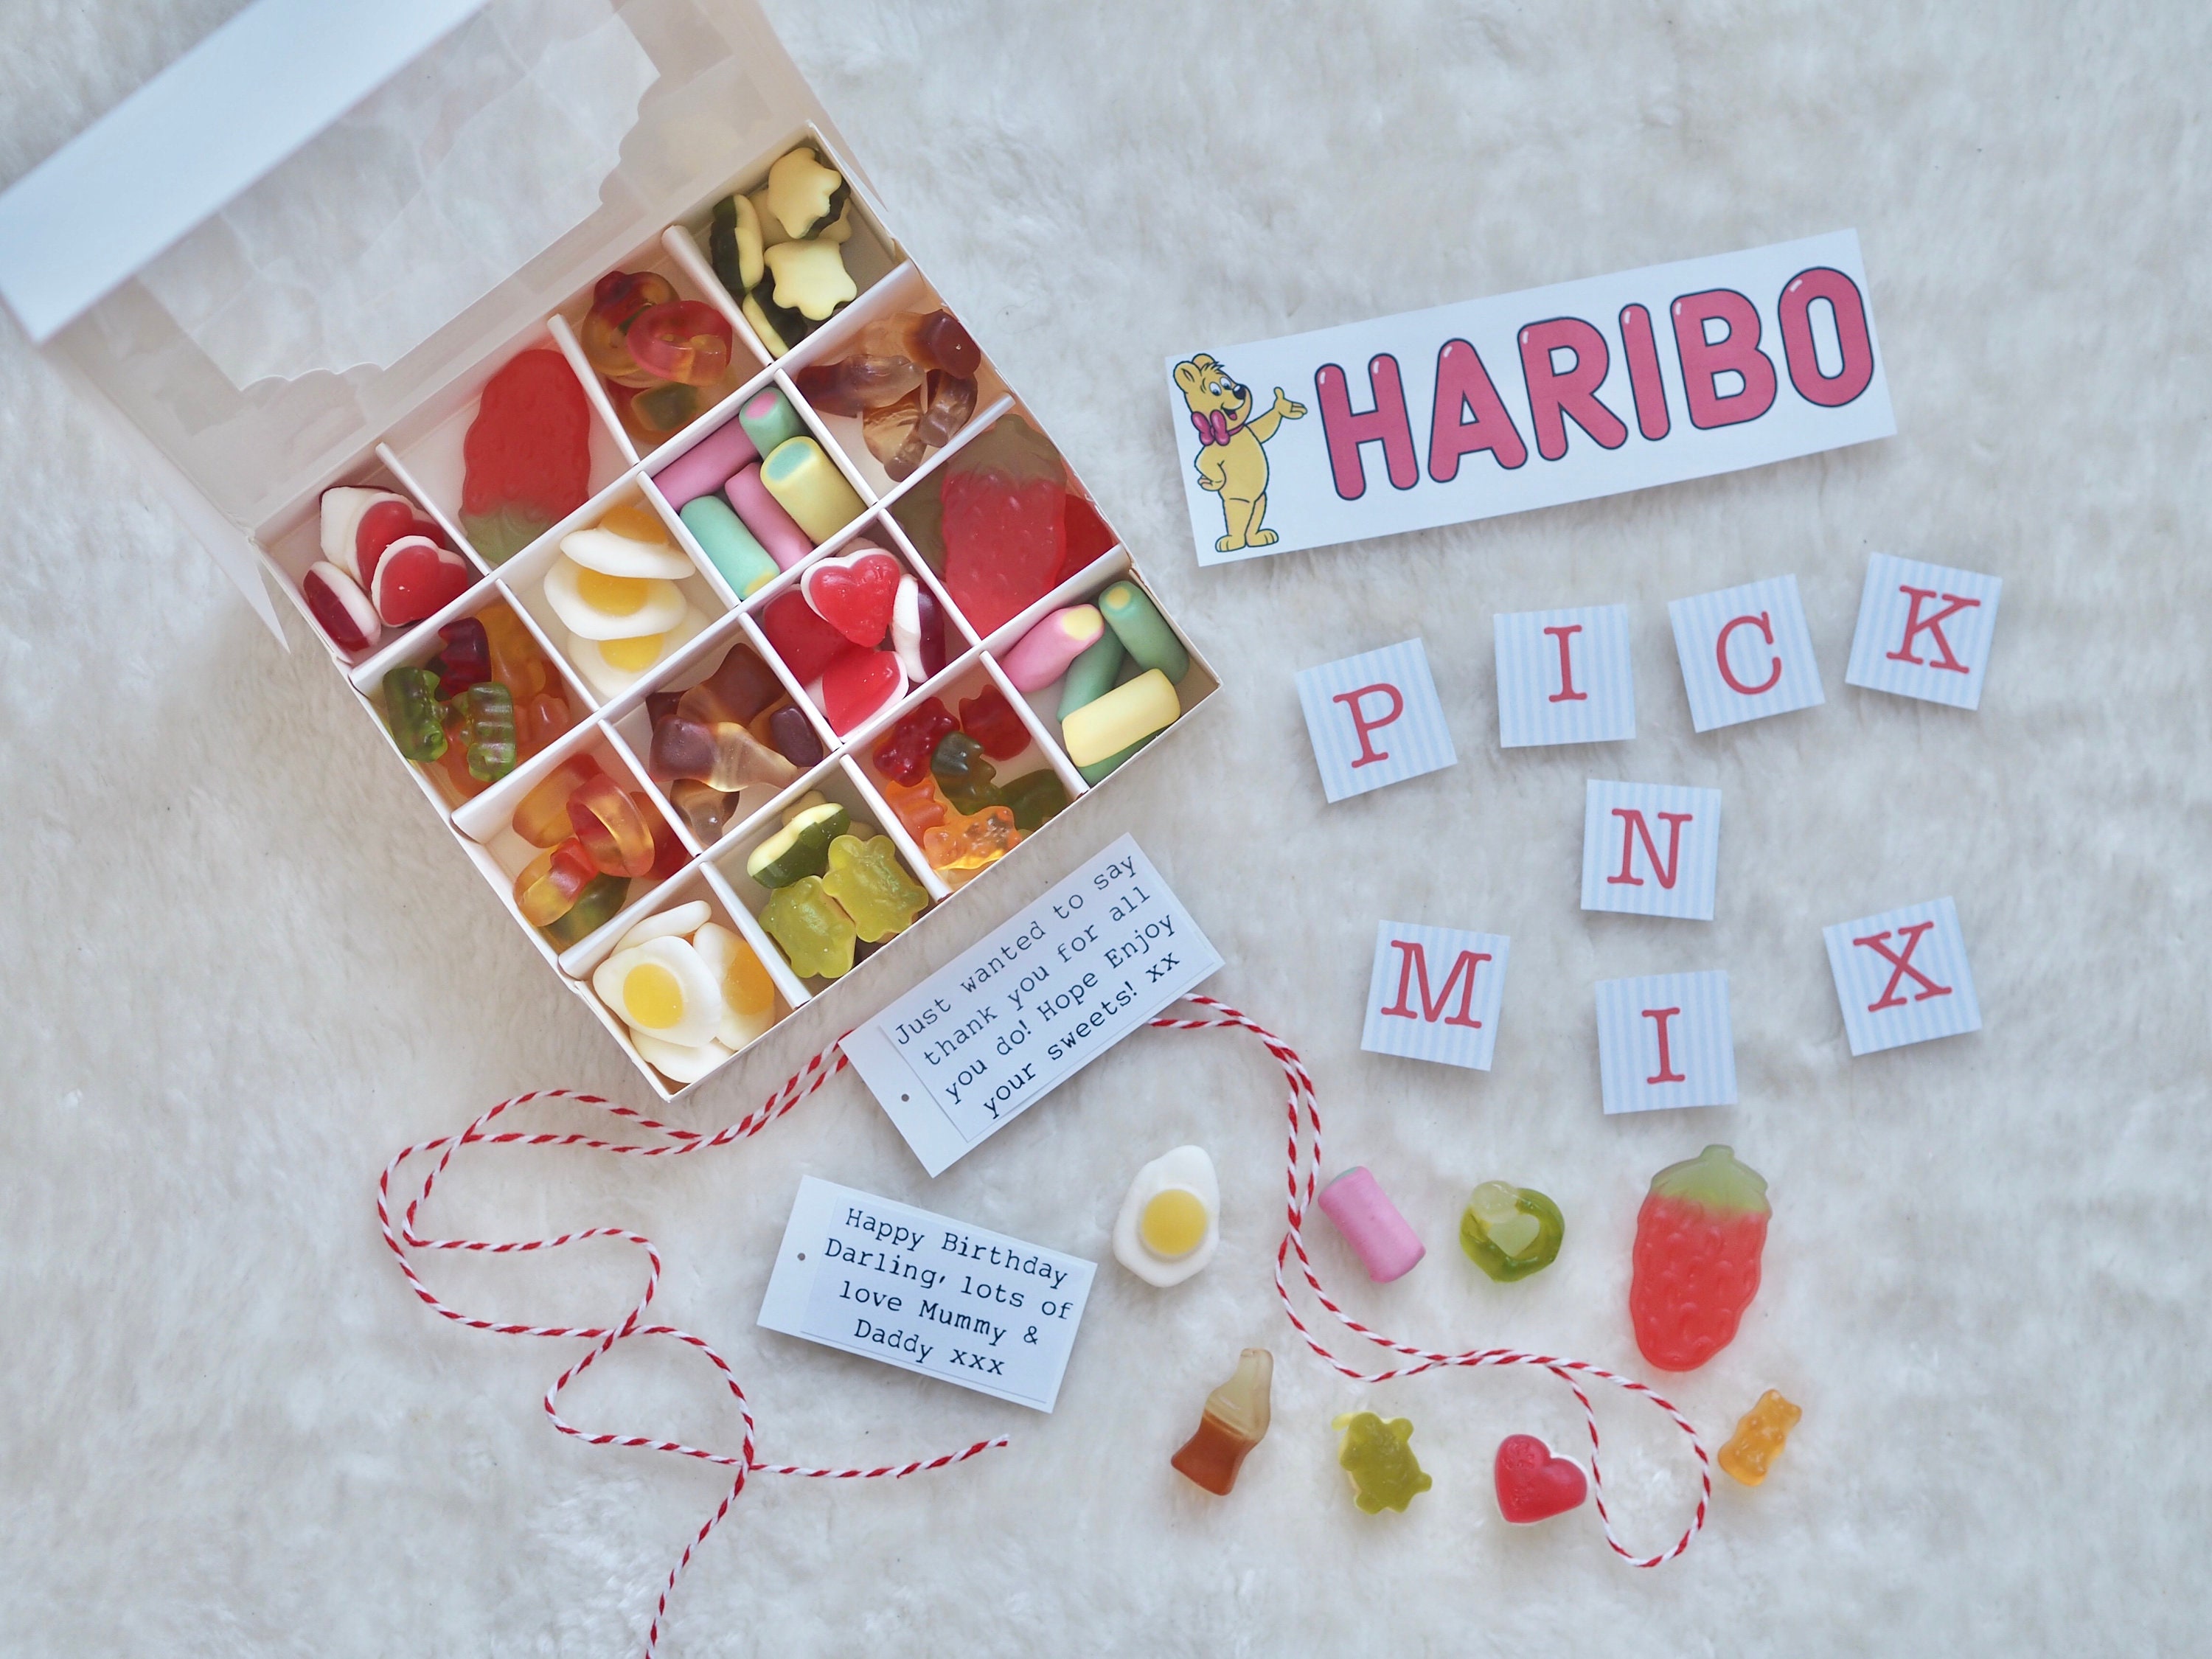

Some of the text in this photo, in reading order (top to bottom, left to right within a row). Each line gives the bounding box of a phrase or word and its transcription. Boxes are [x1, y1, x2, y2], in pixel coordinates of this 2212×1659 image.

[1314, 266, 1875, 501] HARIBO
[1607, 807, 1694, 890] N
[895, 855, 1138, 1044] Just wanted to say
[924, 885, 1151, 1065] thank you for all
[945, 914, 1176, 1105] you do! Hope Enjoy
[983, 951, 1180, 1119] your sweets! xx
[845, 1207, 1068, 1290] Happy Birthday
[960, 1276, 1025, 1308] lots
[1041, 1301, 1074, 1320] of
[838, 1280, 1039, 1347] love Mummy &
[853, 1318, 1005, 1376] Daddy xxx
